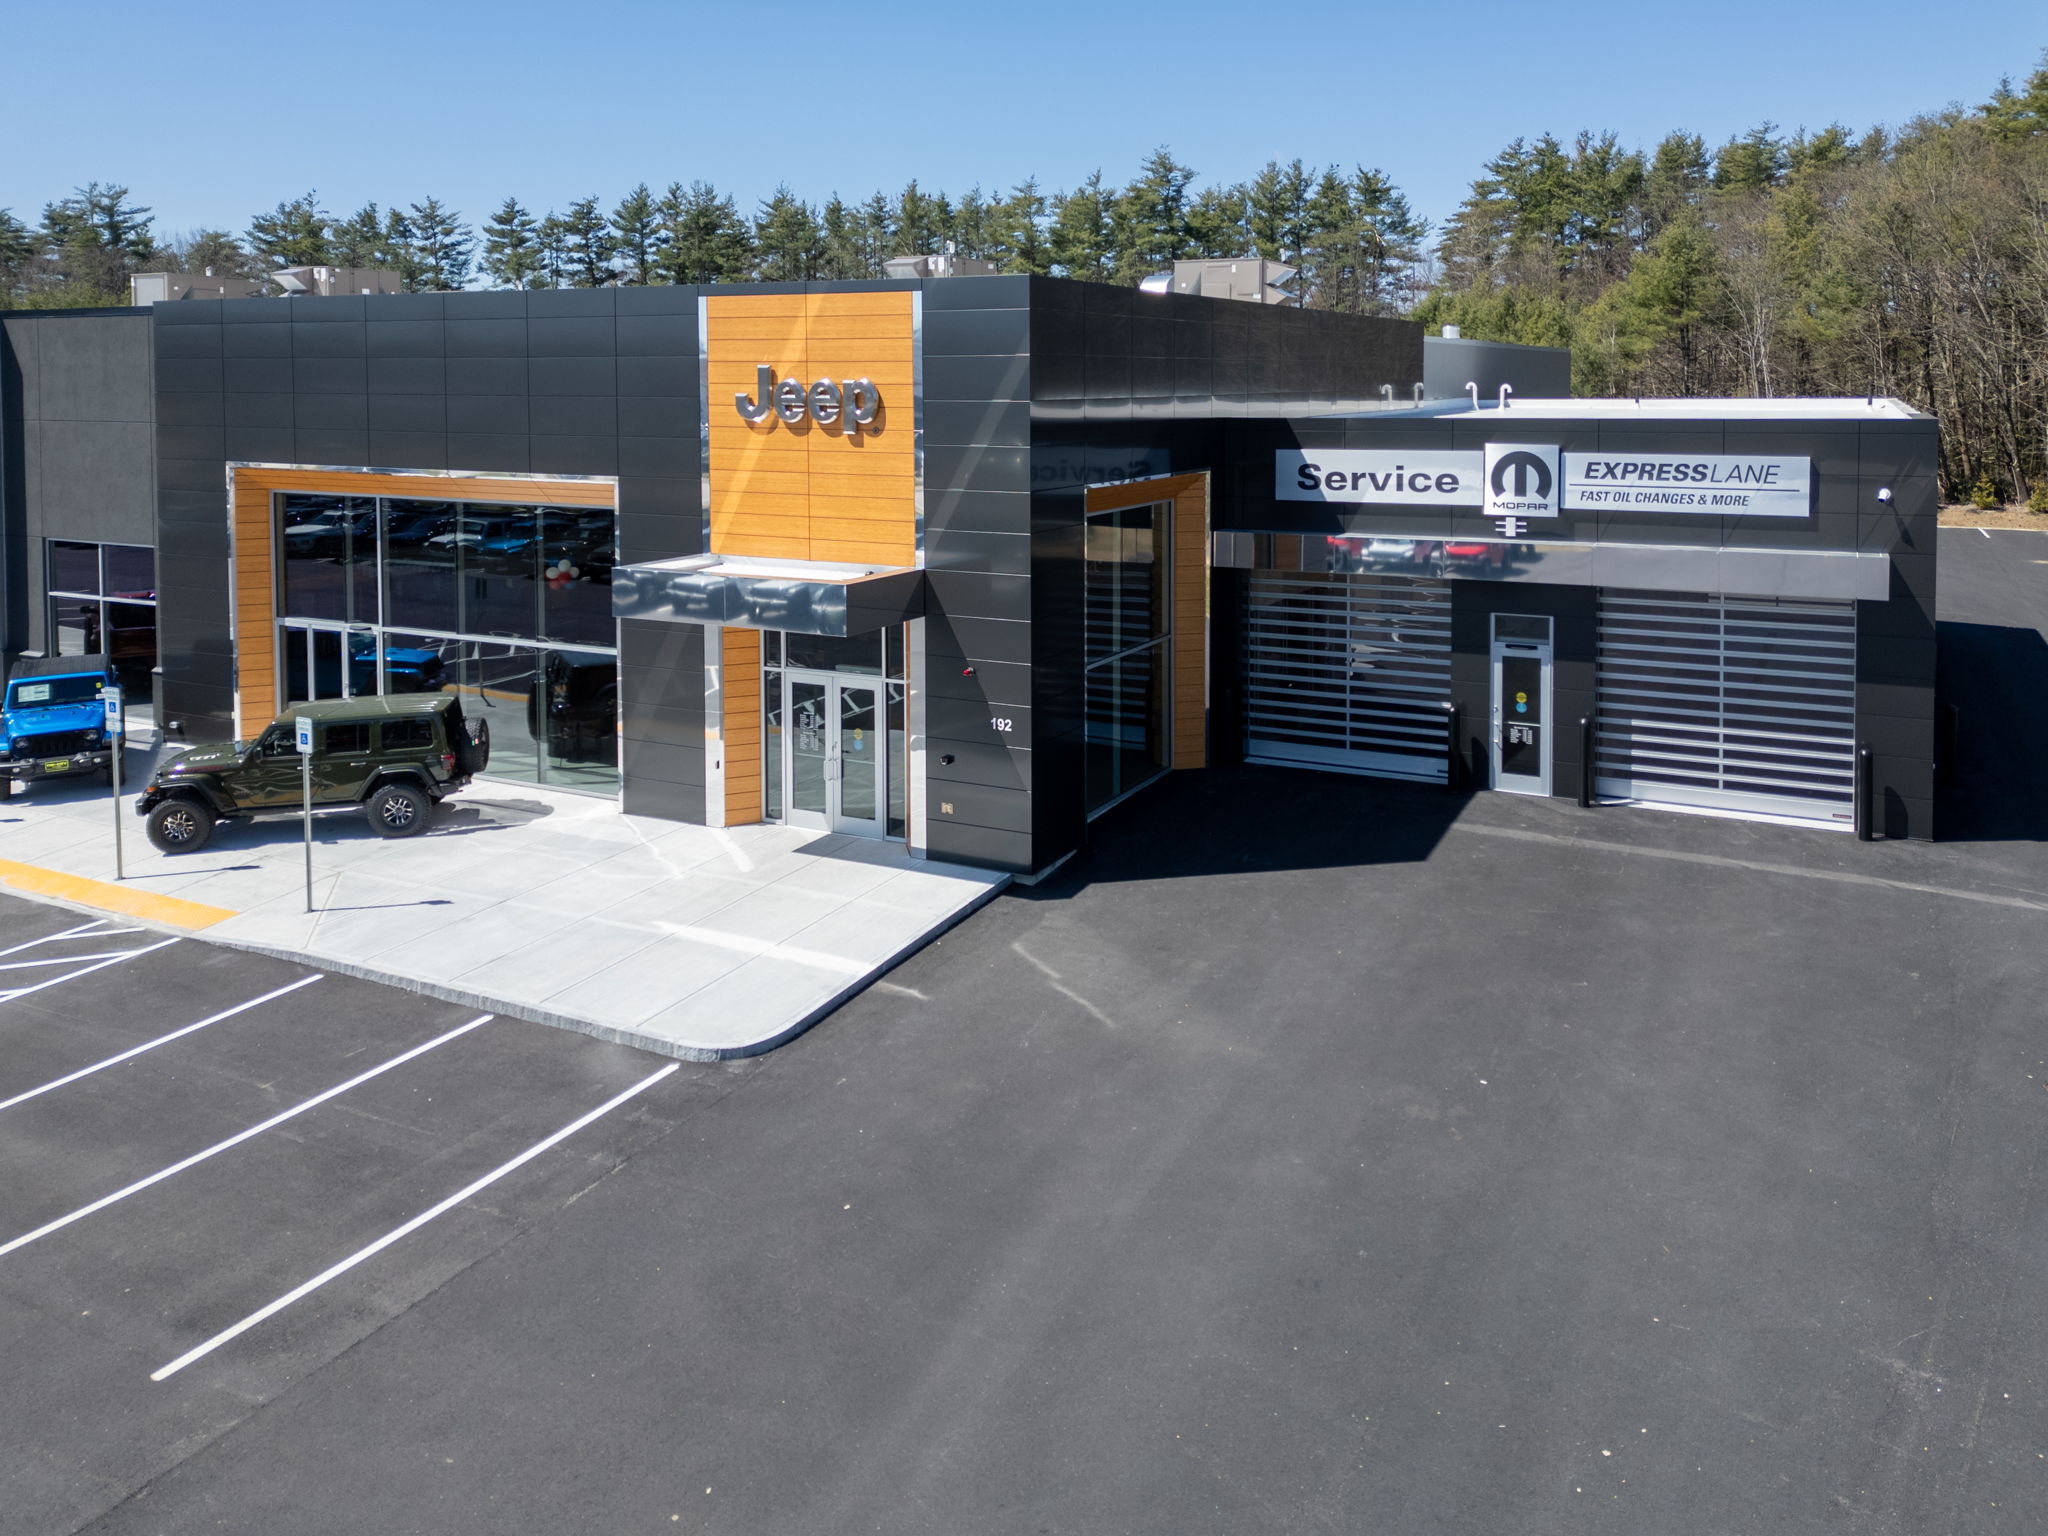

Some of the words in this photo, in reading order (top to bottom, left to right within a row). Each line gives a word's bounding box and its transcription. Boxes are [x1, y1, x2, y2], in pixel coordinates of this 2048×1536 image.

[735, 364, 879, 435] Jeep
[1297, 463, 1460, 493] Service
[1493, 501, 1549, 511] MOPAR
[1580, 491, 1611, 502] FAST
[1613, 491, 1632, 503] OIL
[1634, 492, 1695, 505] CHANGES
[1698, 494, 1708, 506] &
[1711, 494, 1750, 507] MORE
[990, 717, 1013, 732] 192
